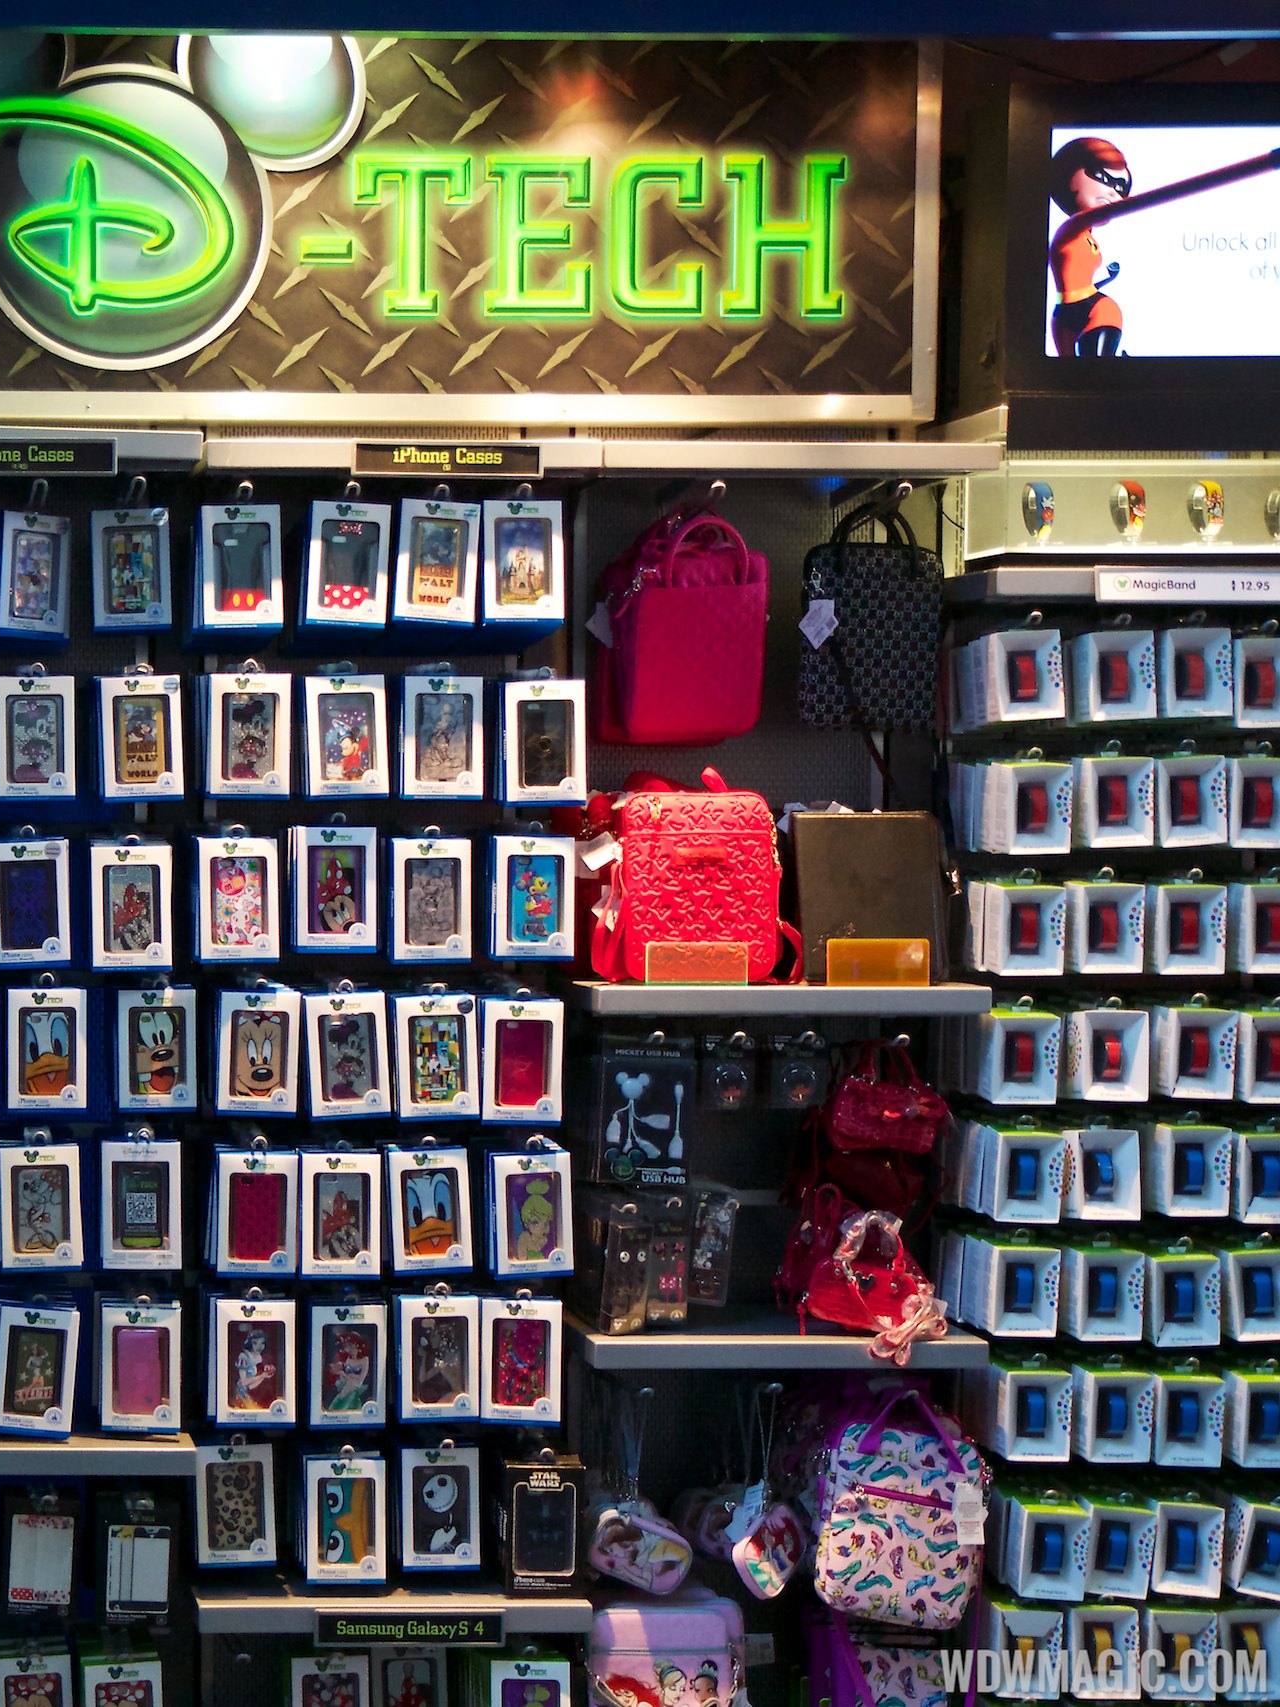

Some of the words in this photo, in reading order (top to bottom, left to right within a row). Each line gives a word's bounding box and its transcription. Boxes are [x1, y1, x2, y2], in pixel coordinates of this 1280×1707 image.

[1182, 231, 1249, 251] Unlock
[1255, 231, 1277, 251] all
[1249, 260, 1267, 280] of
[27, 445, 75, 462] Cases
[392, 446, 450, 464] iPhone
[455, 447, 503, 465] Cases
[1132, 580, 1196, 592] MagicBand
[1240, 581, 1270, 591] 12.95
[641, 1174, 662, 1183] USB
[663, 1175, 686, 1184] HUB
[528, 1471, 561, 1481] STAR
[528, 1479, 561, 1488] WARS
[336, 1620, 405, 1639] Samsung
[407, 1620, 457, 1639] Galaxy
[473, 1620, 485, 1636] 4
